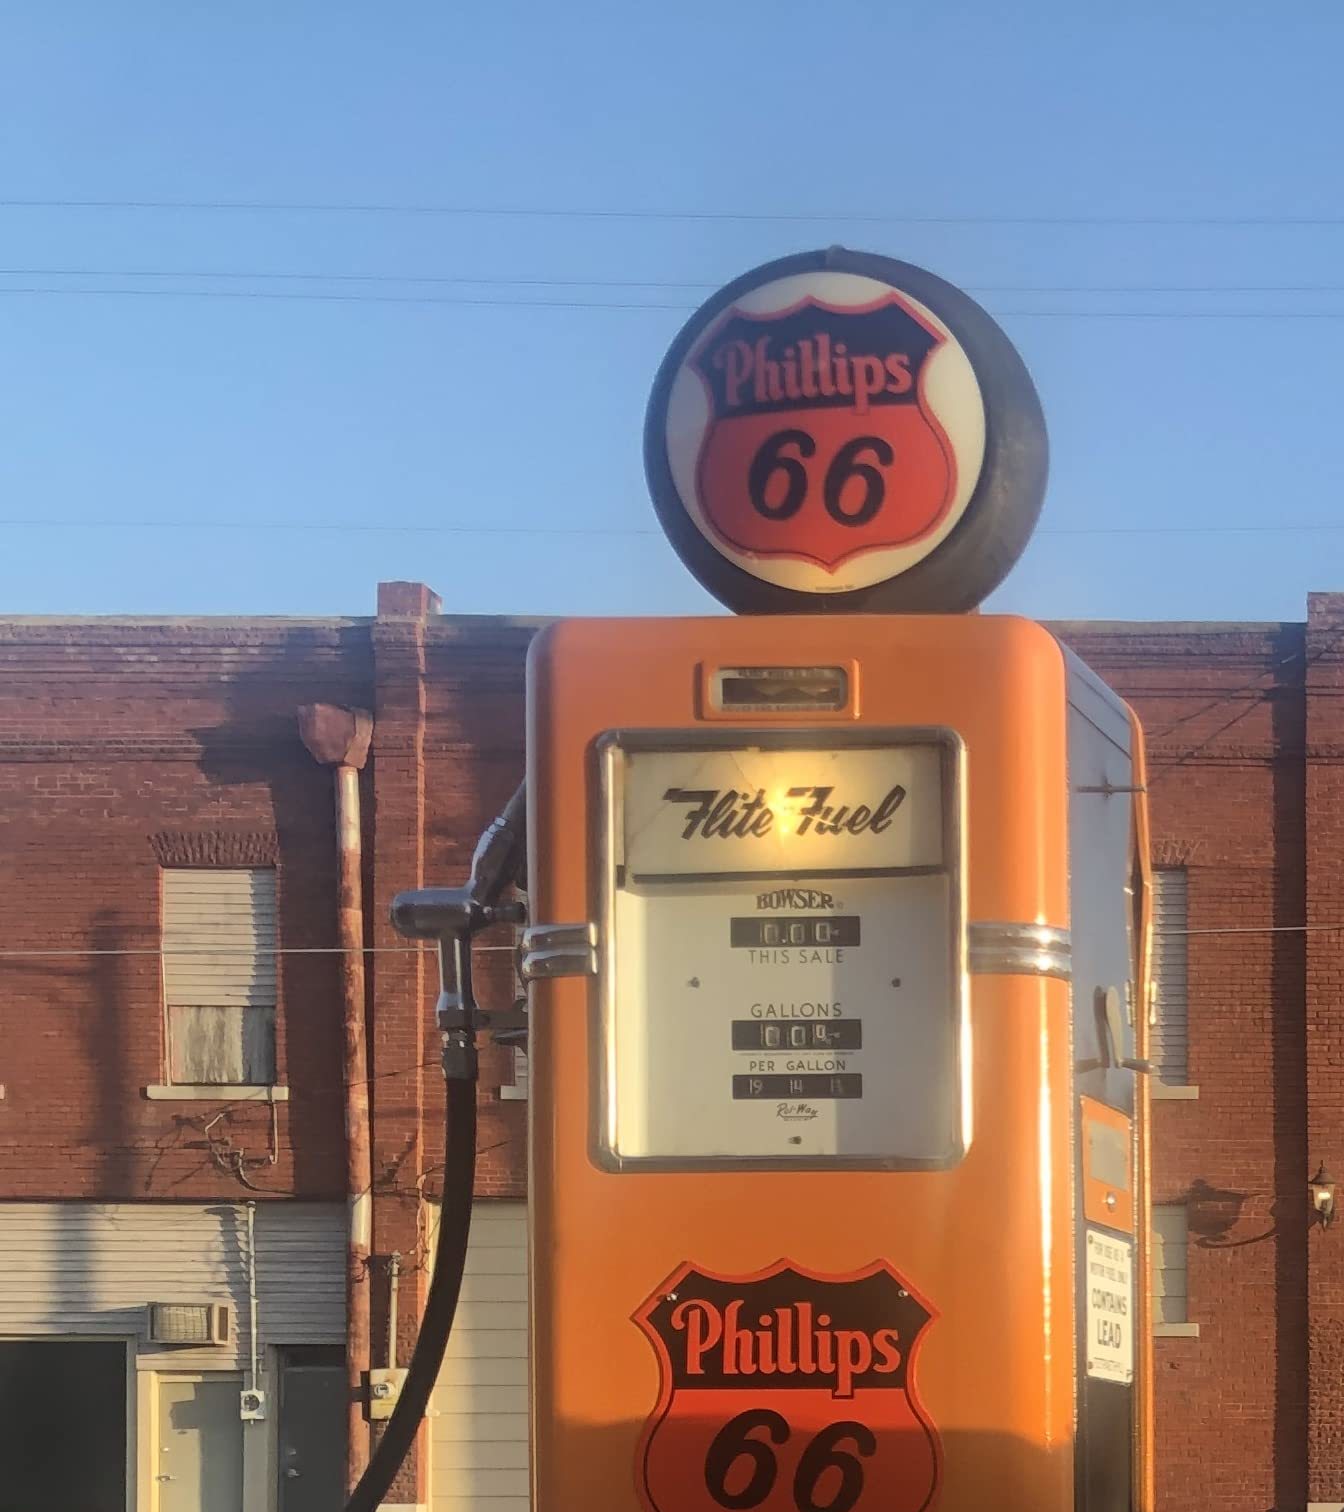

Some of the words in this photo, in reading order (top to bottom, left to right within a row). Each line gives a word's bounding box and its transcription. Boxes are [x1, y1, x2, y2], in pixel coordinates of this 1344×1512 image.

[711, 331, 914, 415] Phillips
[747, 428, 895, 528] 66
[661, 787, 776, 841] Flite
[786, 783, 908, 836] Fuel
[755, 888, 835, 910] BOWSER
[748, 949, 791, 965] THIS
[799, 948, 845, 965] SALE
[750, 1002, 844, 1018] GALLONS
[749, 1060, 776, 1072] PER
[786, 1059, 847, 1072] GALLON
[1091, 1287, 1128, 1316] CONTAINS
[670, 1297, 902, 1399] Phillips
[1097, 1319, 1122, 1349] LEAD
